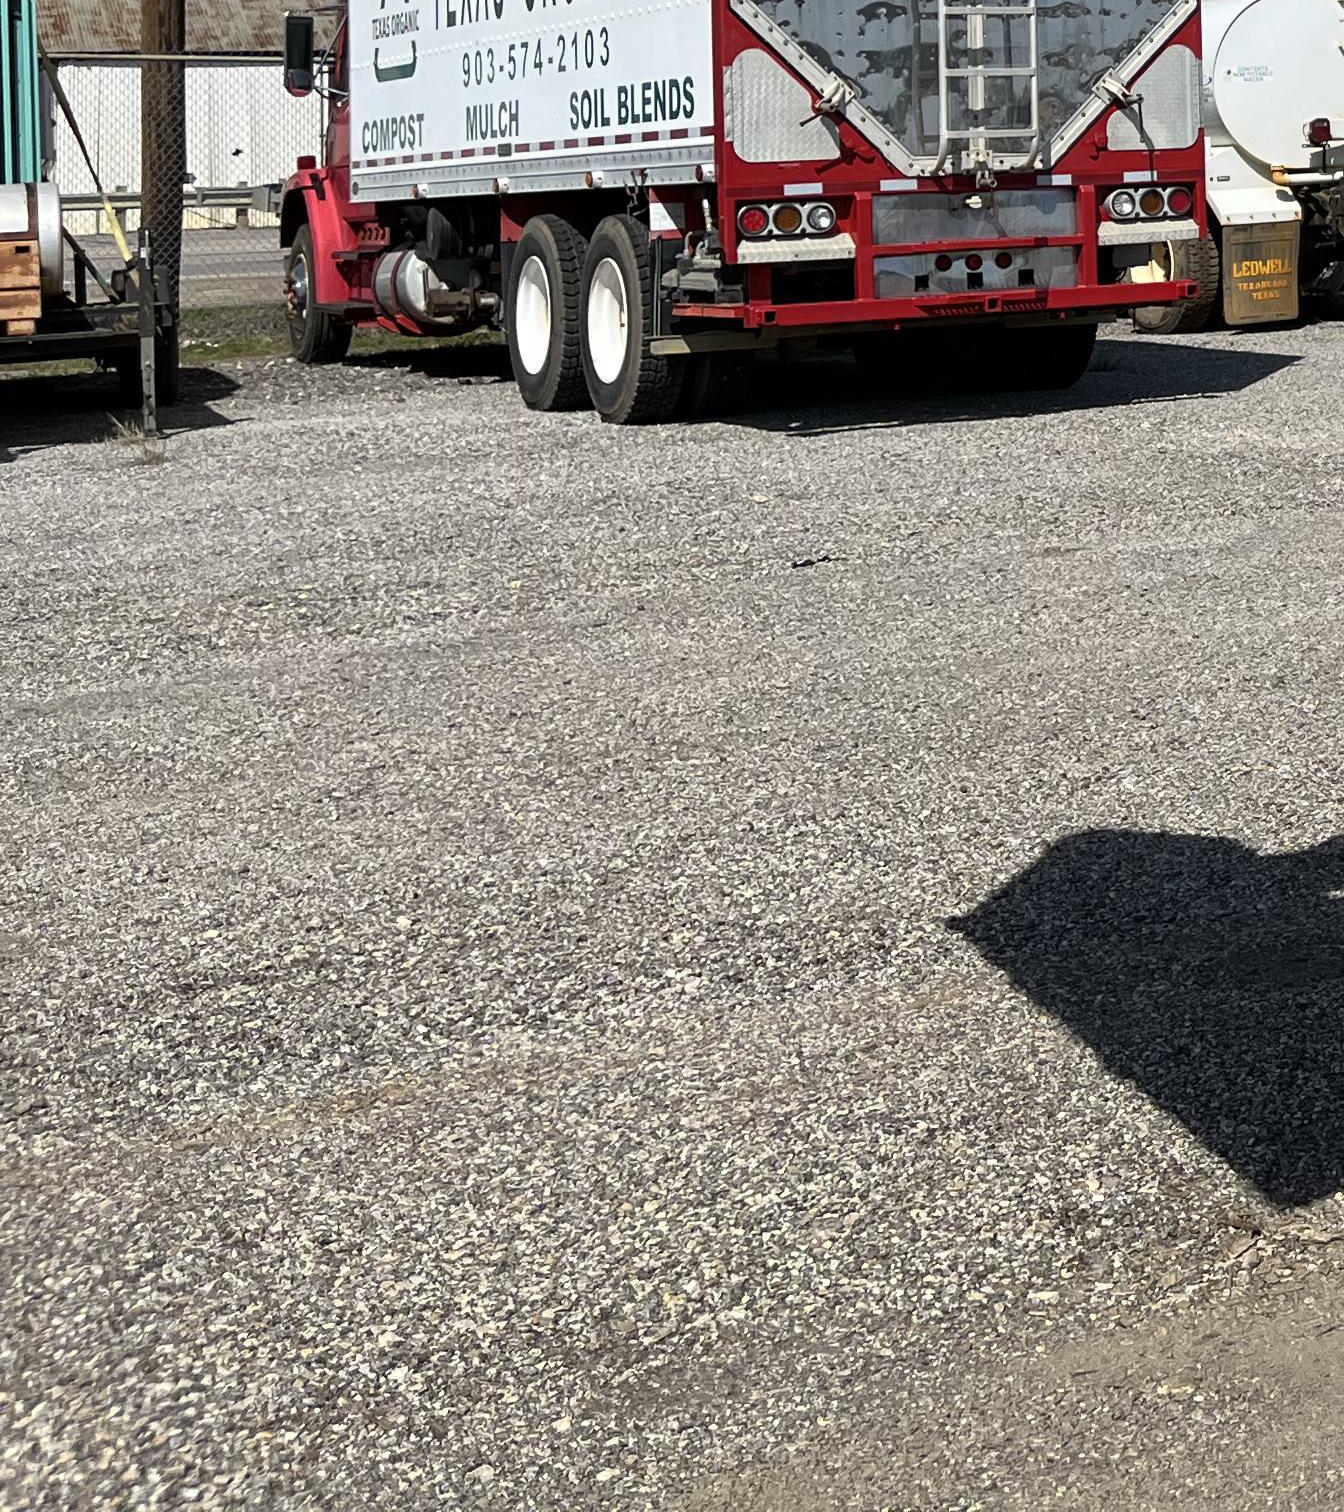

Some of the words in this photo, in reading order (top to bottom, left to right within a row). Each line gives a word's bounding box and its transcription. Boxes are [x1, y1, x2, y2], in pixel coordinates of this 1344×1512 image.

[371, 16, 391, 40] TEXAS
[391, 8, 420, 36] ORGANIC
[462, 26, 611, 88] 903-574-2103
[465, 99, 520, 142] MULCH
[569, 87, 611, 130] SOIL
[617, 75, 696, 126] BLENDS
[362, 112, 426, 156] COMPOST
[1232, 258, 1292, 279] LEDWELL
